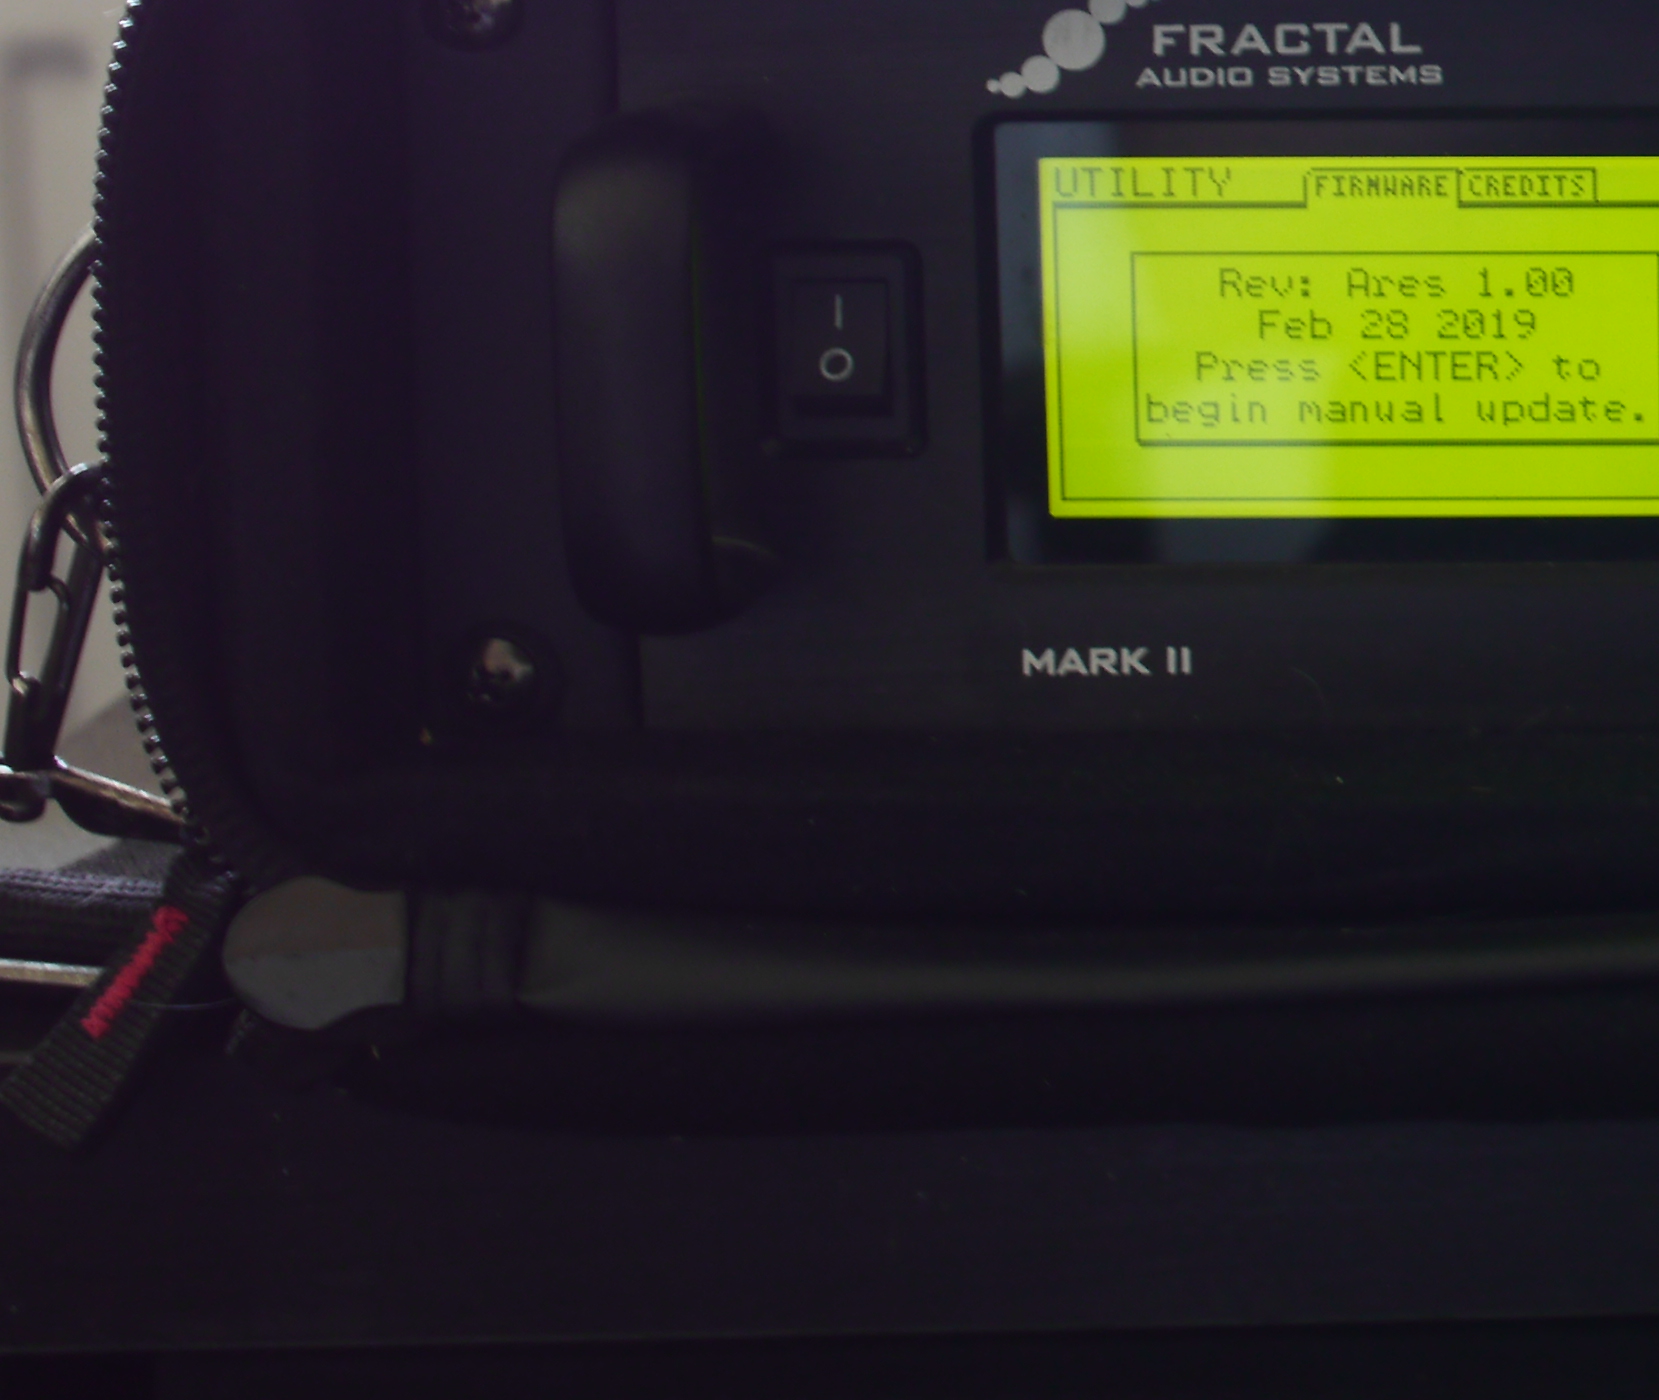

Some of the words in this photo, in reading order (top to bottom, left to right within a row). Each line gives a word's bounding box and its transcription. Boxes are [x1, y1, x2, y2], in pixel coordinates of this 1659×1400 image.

[1152, 22, 1422, 56] FRACTAL
[1135, 66, 1253, 87] AUDIO
[1268, 64, 1443, 86] SYSTEMS
[1055, 166, 1231, 198] UTILITY
[1316, 172, 1450, 200] FIRMWARE
[1467, 172, 1587, 200] CREDITS
[1219, 267, 1311, 299] Rev:
[1346, 267, 1447, 298] Ares
[1478, 266, 1574, 298] 1.00
[1258, 309, 1333, 340] Feb
[1360, 308, 1410, 340] 28
[1437, 308, 1537, 340] 2019
[1195, 350, 1321, 382] Press
[1348, 350, 1524, 382] <ENTER>
[1552, 354, 1601, 382] to
[1144, 392, 1267, 428] begin
[1299, 392, 1445, 424] manual
[1476, 392, 1645, 427] update.
[1022, 647, 1150, 676] MARK
[1166, 646, 1192, 675] II
